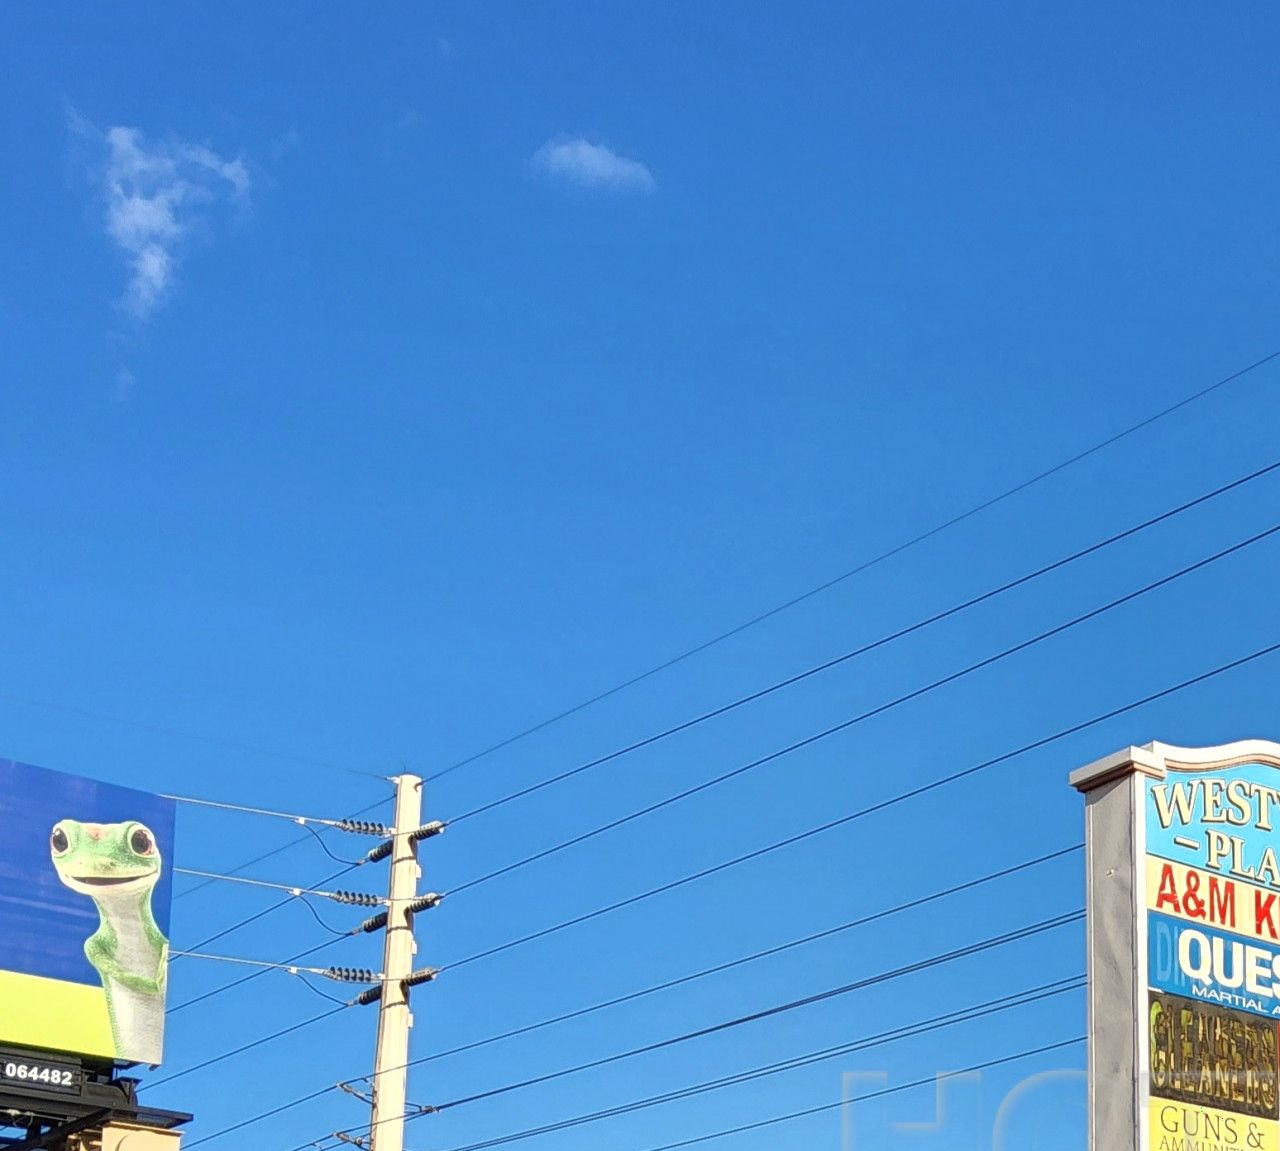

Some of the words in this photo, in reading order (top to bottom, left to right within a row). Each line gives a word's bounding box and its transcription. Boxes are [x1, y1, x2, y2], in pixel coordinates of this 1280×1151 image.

[1156, 863, 1236, 928] A&M
[1191, 984, 1269, 1014] MARTIAL
[5, 1062, 73, 1086] 064482
[1160, 1105, 1239, 1144] GUNS
[1246, 1121, 1266, 1151] &
